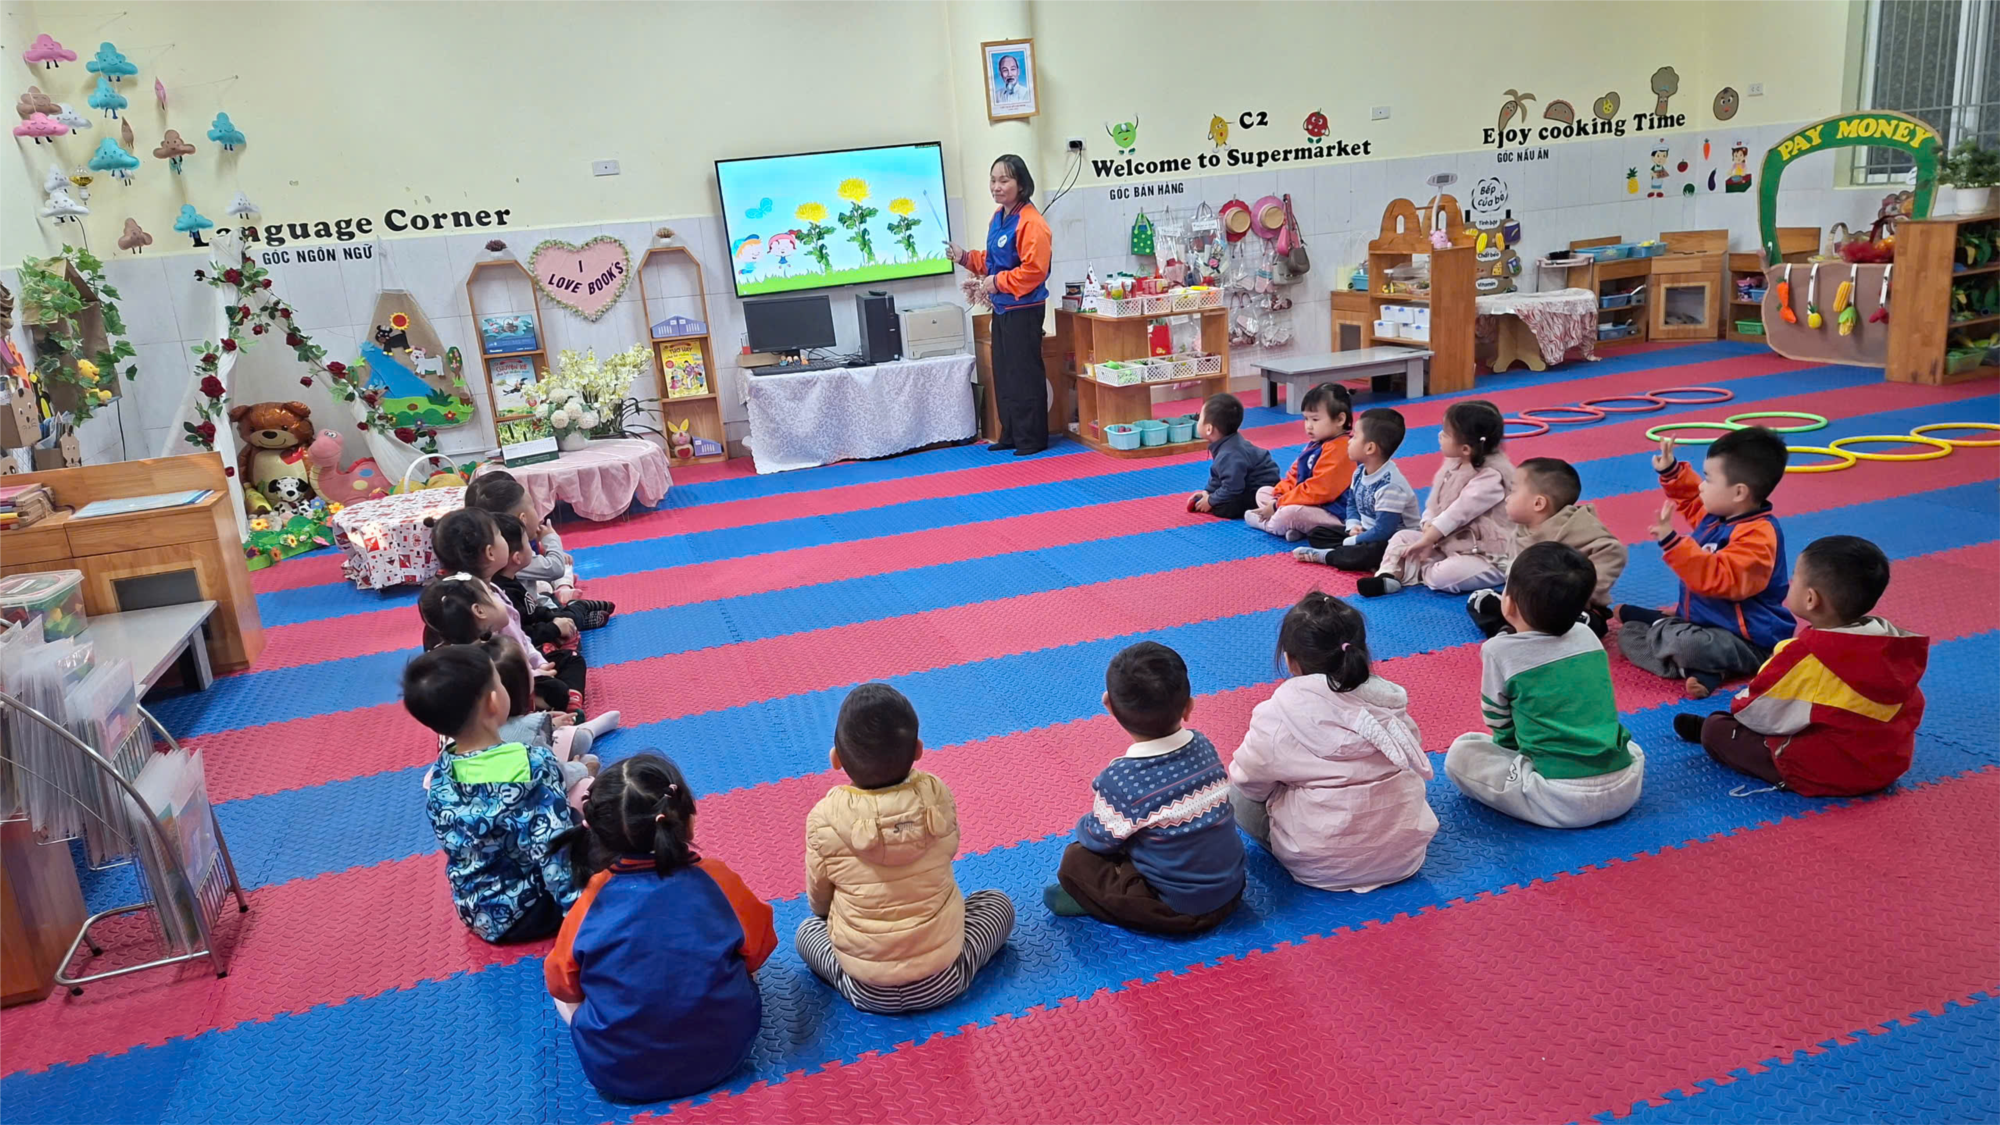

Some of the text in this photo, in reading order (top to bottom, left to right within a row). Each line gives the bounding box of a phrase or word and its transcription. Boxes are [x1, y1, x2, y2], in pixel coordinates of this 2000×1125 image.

[1239, 112, 1268, 129] C2
[1482, 113, 1686, 148] Ejoy cooking Time
[1777, 118, 1932, 161] PAY MONEY
[1092, 140, 1372, 178] Welcome to Supermarket
[1497, 150, 1514, 163] GÓC
[1517, 148, 1535, 161] NẤU
[1110, 181, 1184, 200] GÓC BÁN HÀNG
[1480, 183, 1496, 196] Bếp
[384, 209, 511, 231] Corner
[262, 244, 373, 265] GÓC NGÔN NGỮ
[578, 260, 583, 273] I
[548, 273, 583, 293] LOVE
